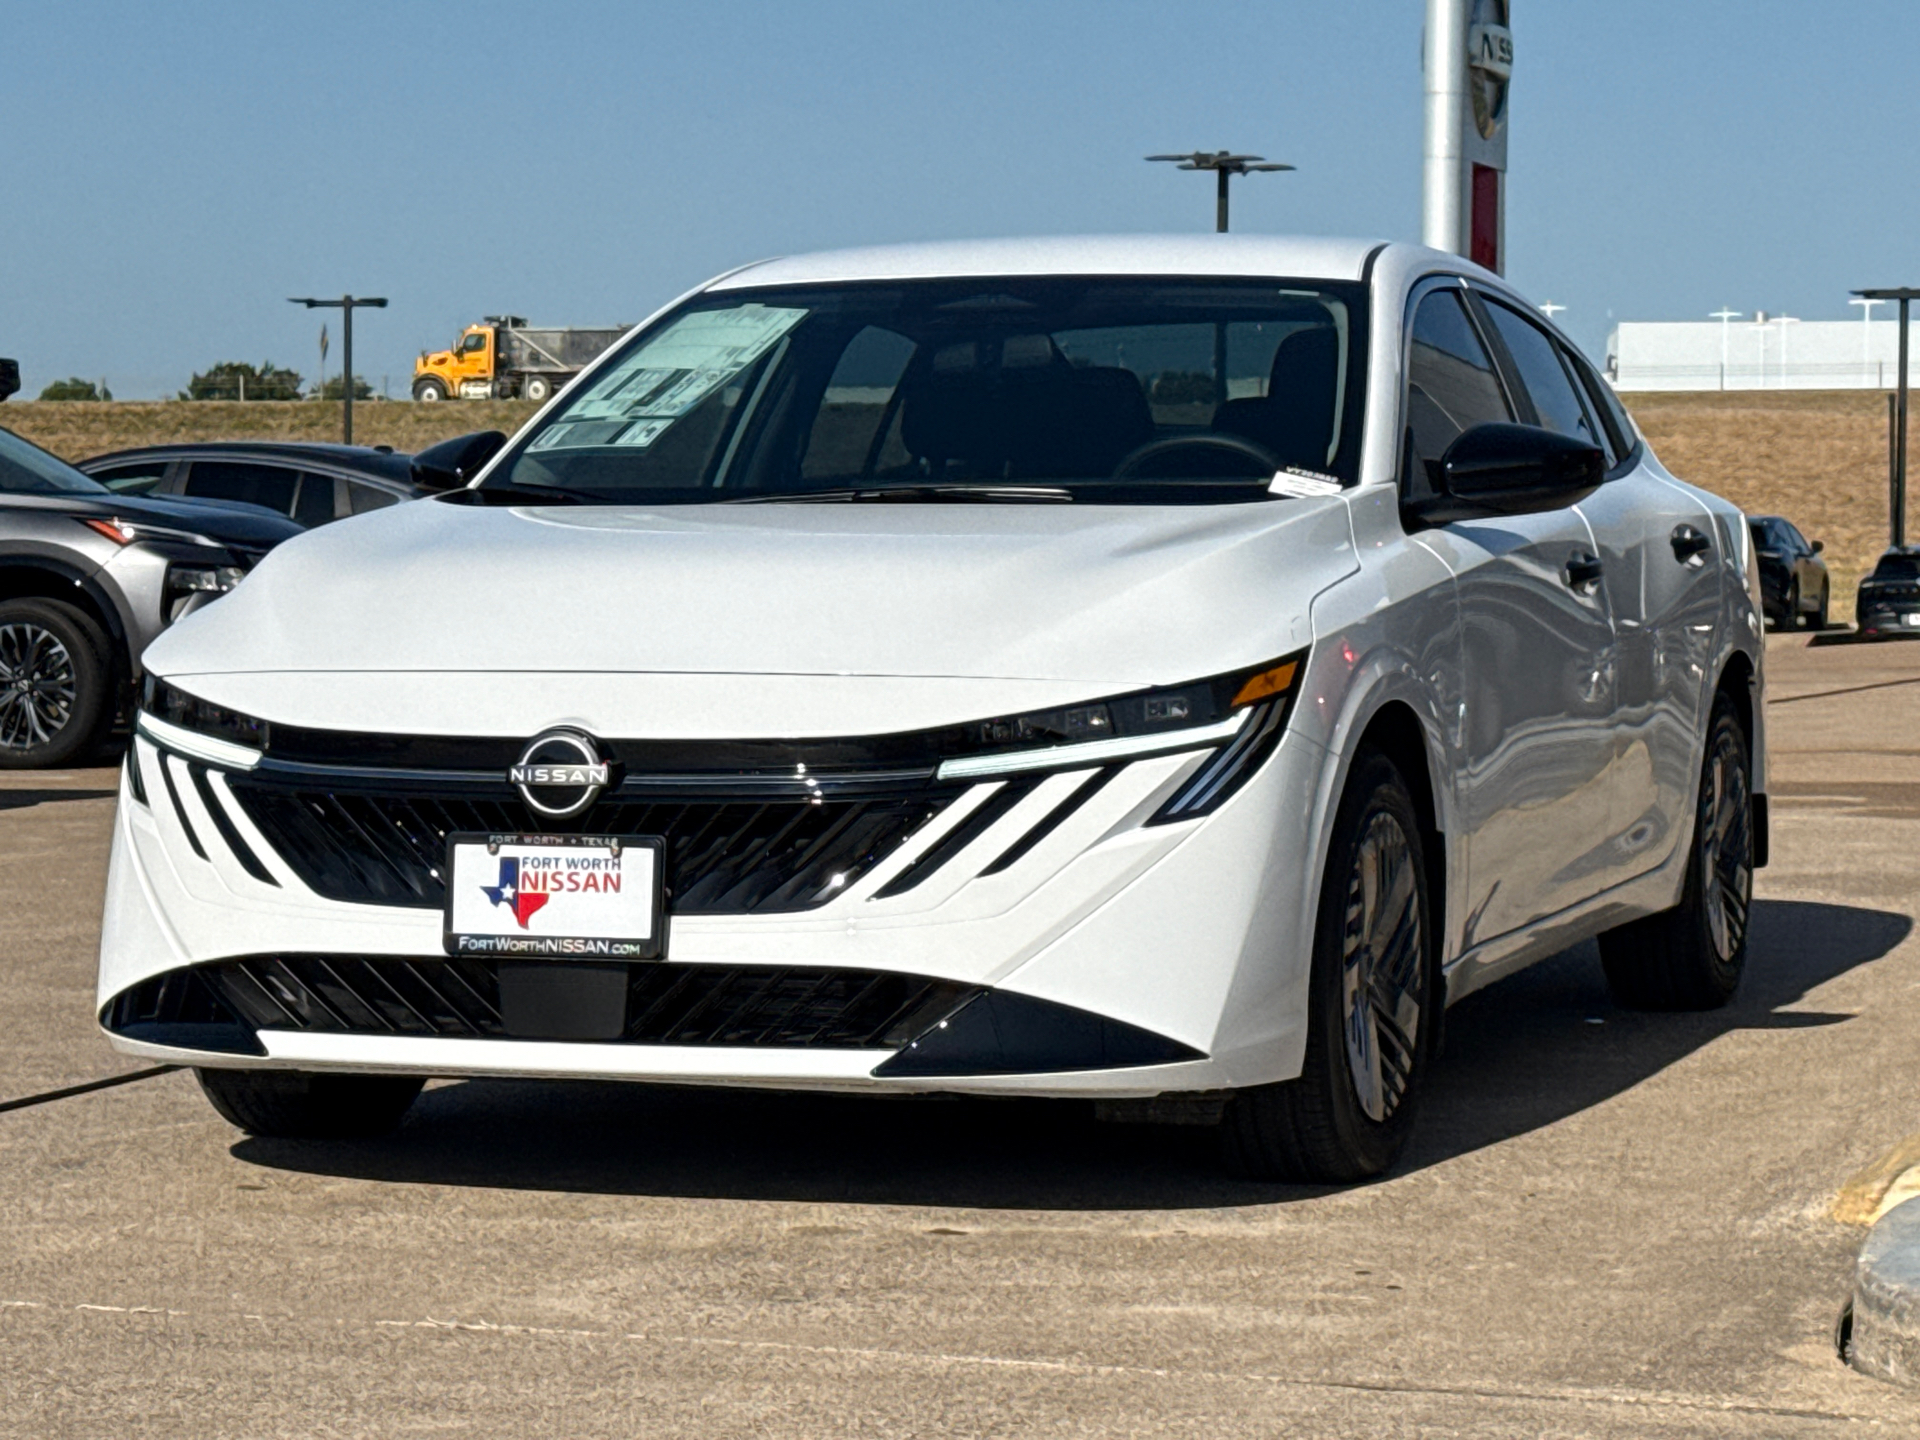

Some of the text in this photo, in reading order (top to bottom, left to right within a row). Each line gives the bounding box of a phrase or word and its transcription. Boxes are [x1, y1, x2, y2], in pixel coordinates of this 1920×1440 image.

[510, 767, 605, 783] NISSAN
[489, 834, 619, 847] FORT WORTH TEXAS
[521, 857, 622, 871] FORT WORTH
[521, 871, 621, 893] NISSAN
